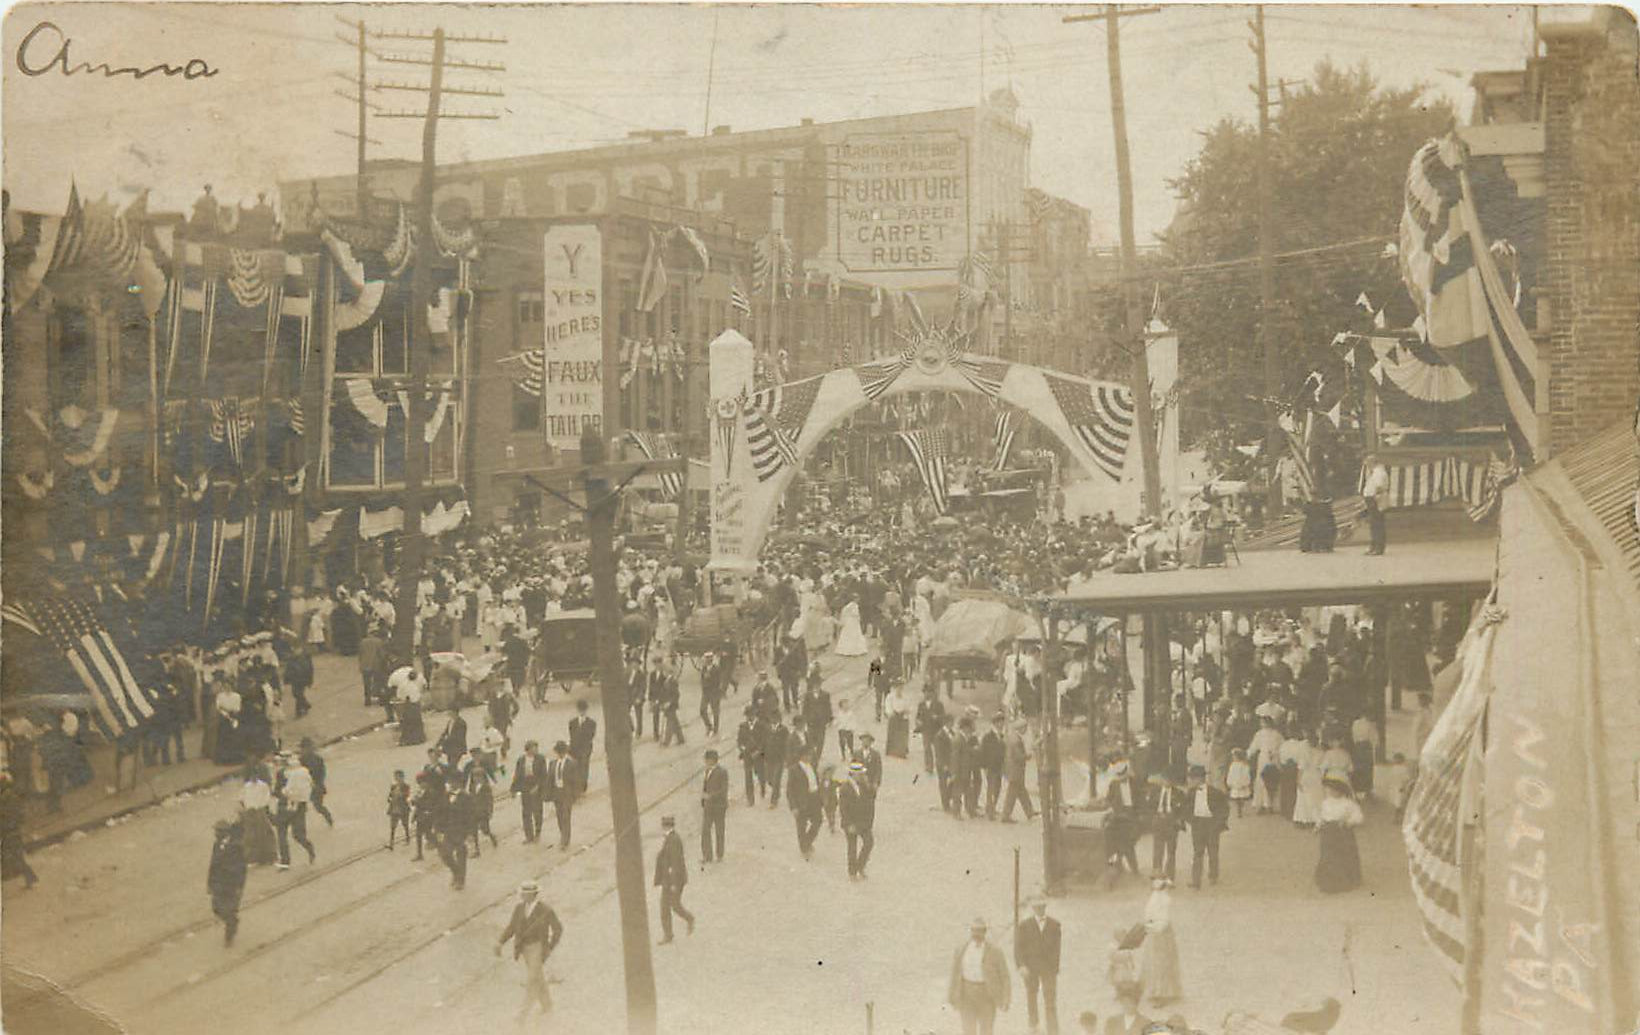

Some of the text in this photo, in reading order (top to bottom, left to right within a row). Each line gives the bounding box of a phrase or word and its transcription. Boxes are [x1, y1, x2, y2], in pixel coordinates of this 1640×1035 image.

[849, 161, 894, 174] WHITE
[843, 176, 961, 203] FURNITURE
[898, 206, 955, 220] PAPER
[857, 223, 943, 243] CARPET
[561, 243, 584, 279] Y
[552, 288, 597, 305] YES
[548, 360, 602, 383] FAUX
